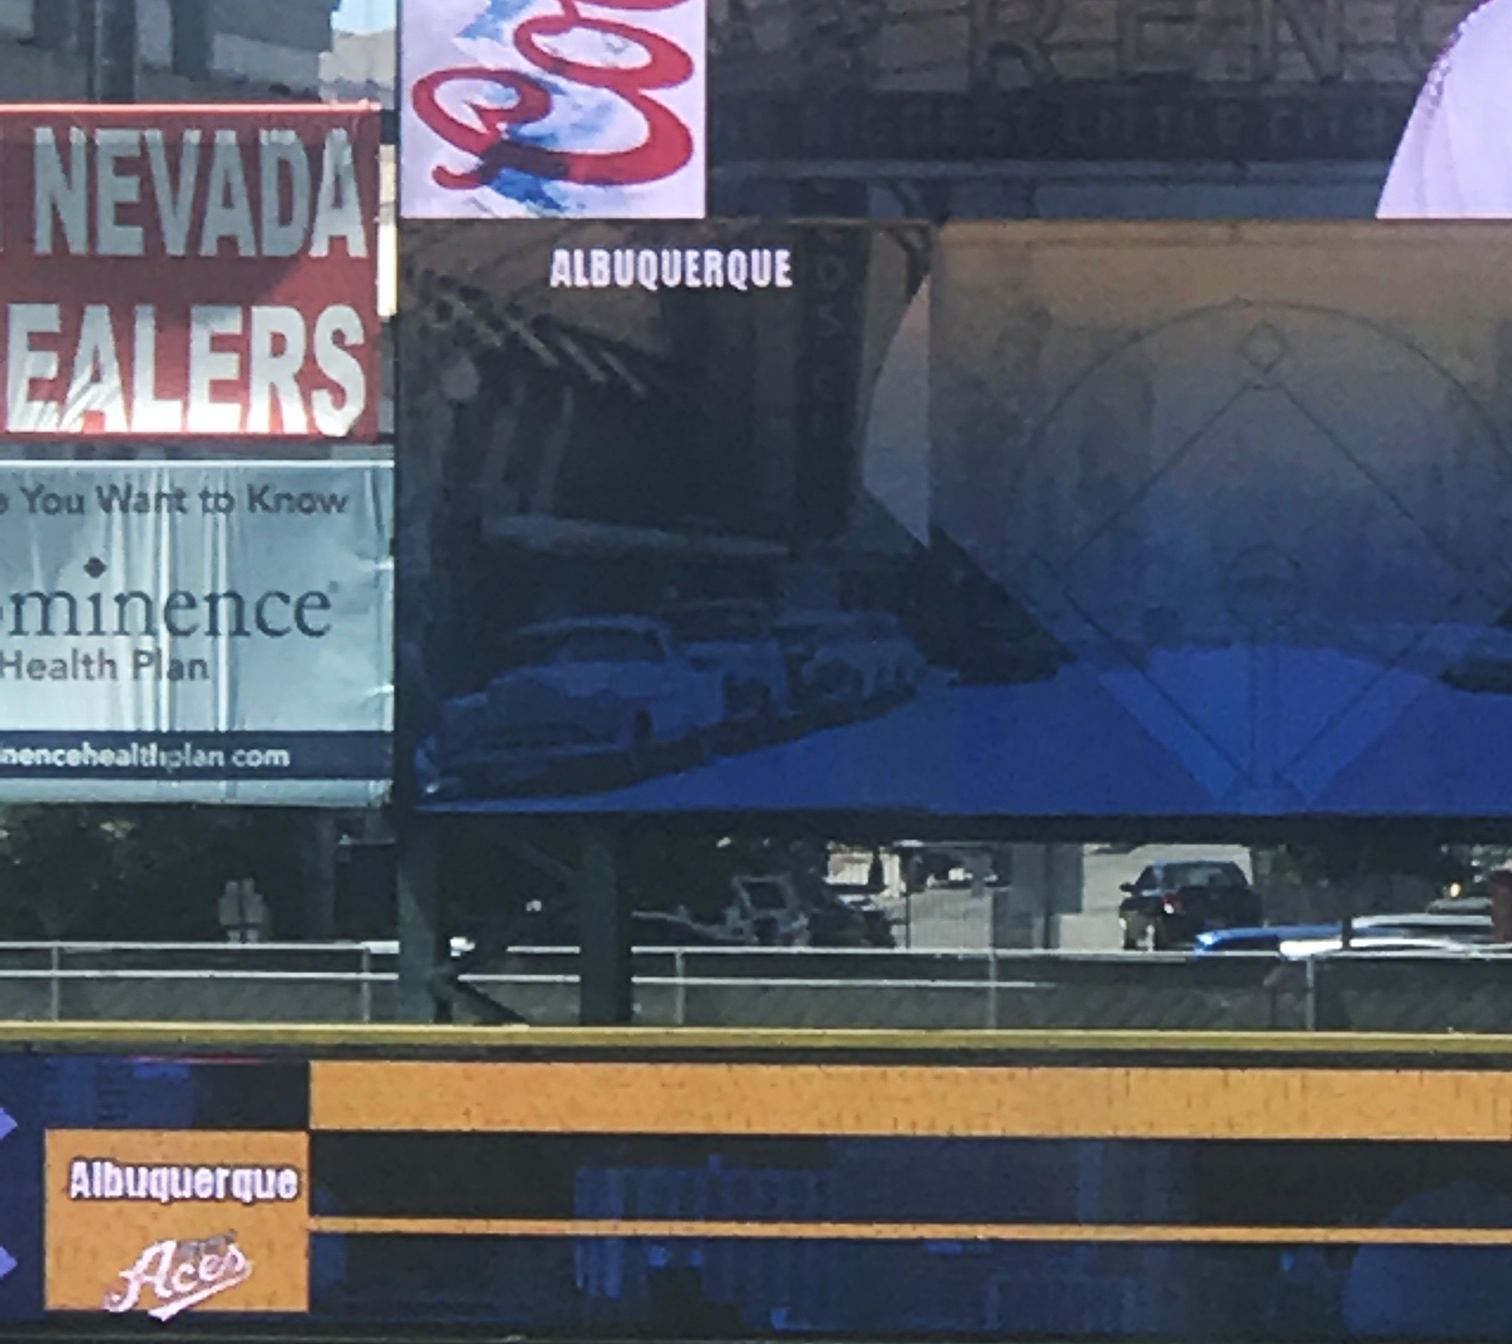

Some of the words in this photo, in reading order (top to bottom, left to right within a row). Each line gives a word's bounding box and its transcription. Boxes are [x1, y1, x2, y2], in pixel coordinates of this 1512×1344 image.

[34, 127, 368, 257] NEVADA
[549, 248, 793, 291] ALBUQUERQUE
[6, 303, 366, 436] EALERS
[21, 483, 85, 516] You
[97, 484, 189, 515] Want
[201, 486, 236, 515] to
[248, 483, 350, 515] Know
[0, 556, 332, 638] minence
[0, 647, 119, 681] Health
[133, 647, 210, 681] Plan
[0, 742, 291, 773] nencehealthplancom
[70, 1160, 298, 1204] Albuquerque
[104, 1238, 252, 1316] Aces
